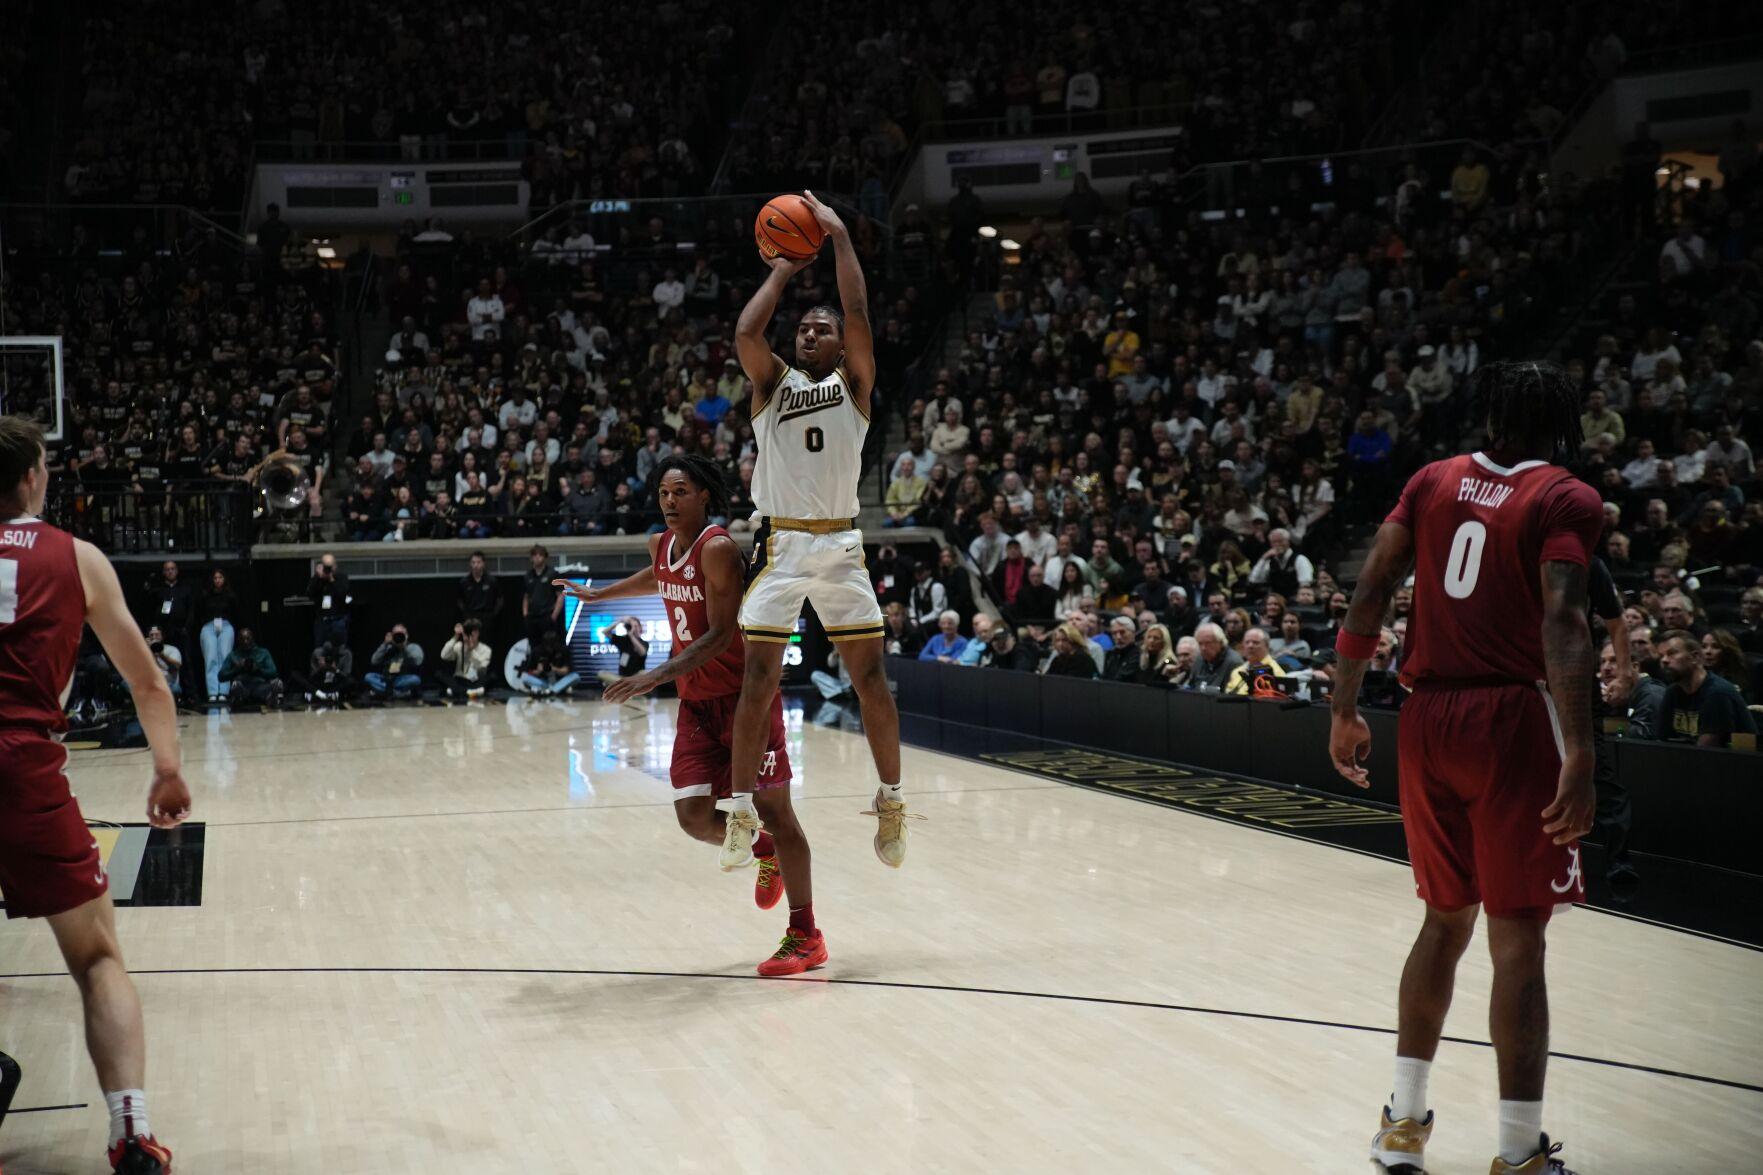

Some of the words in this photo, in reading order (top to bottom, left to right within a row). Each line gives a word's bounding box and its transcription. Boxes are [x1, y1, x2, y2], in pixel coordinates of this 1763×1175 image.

[777, 384, 844, 412] Purdue
[805, 426, 824, 453] 0
[1458, 477, 1514, 509] PHILON
[1444, 520, 1487, 599] 0
[674, 606, 693, 641] 2
[759, 750, 777, 777] A
[1550, 846, 1584, 893] A
